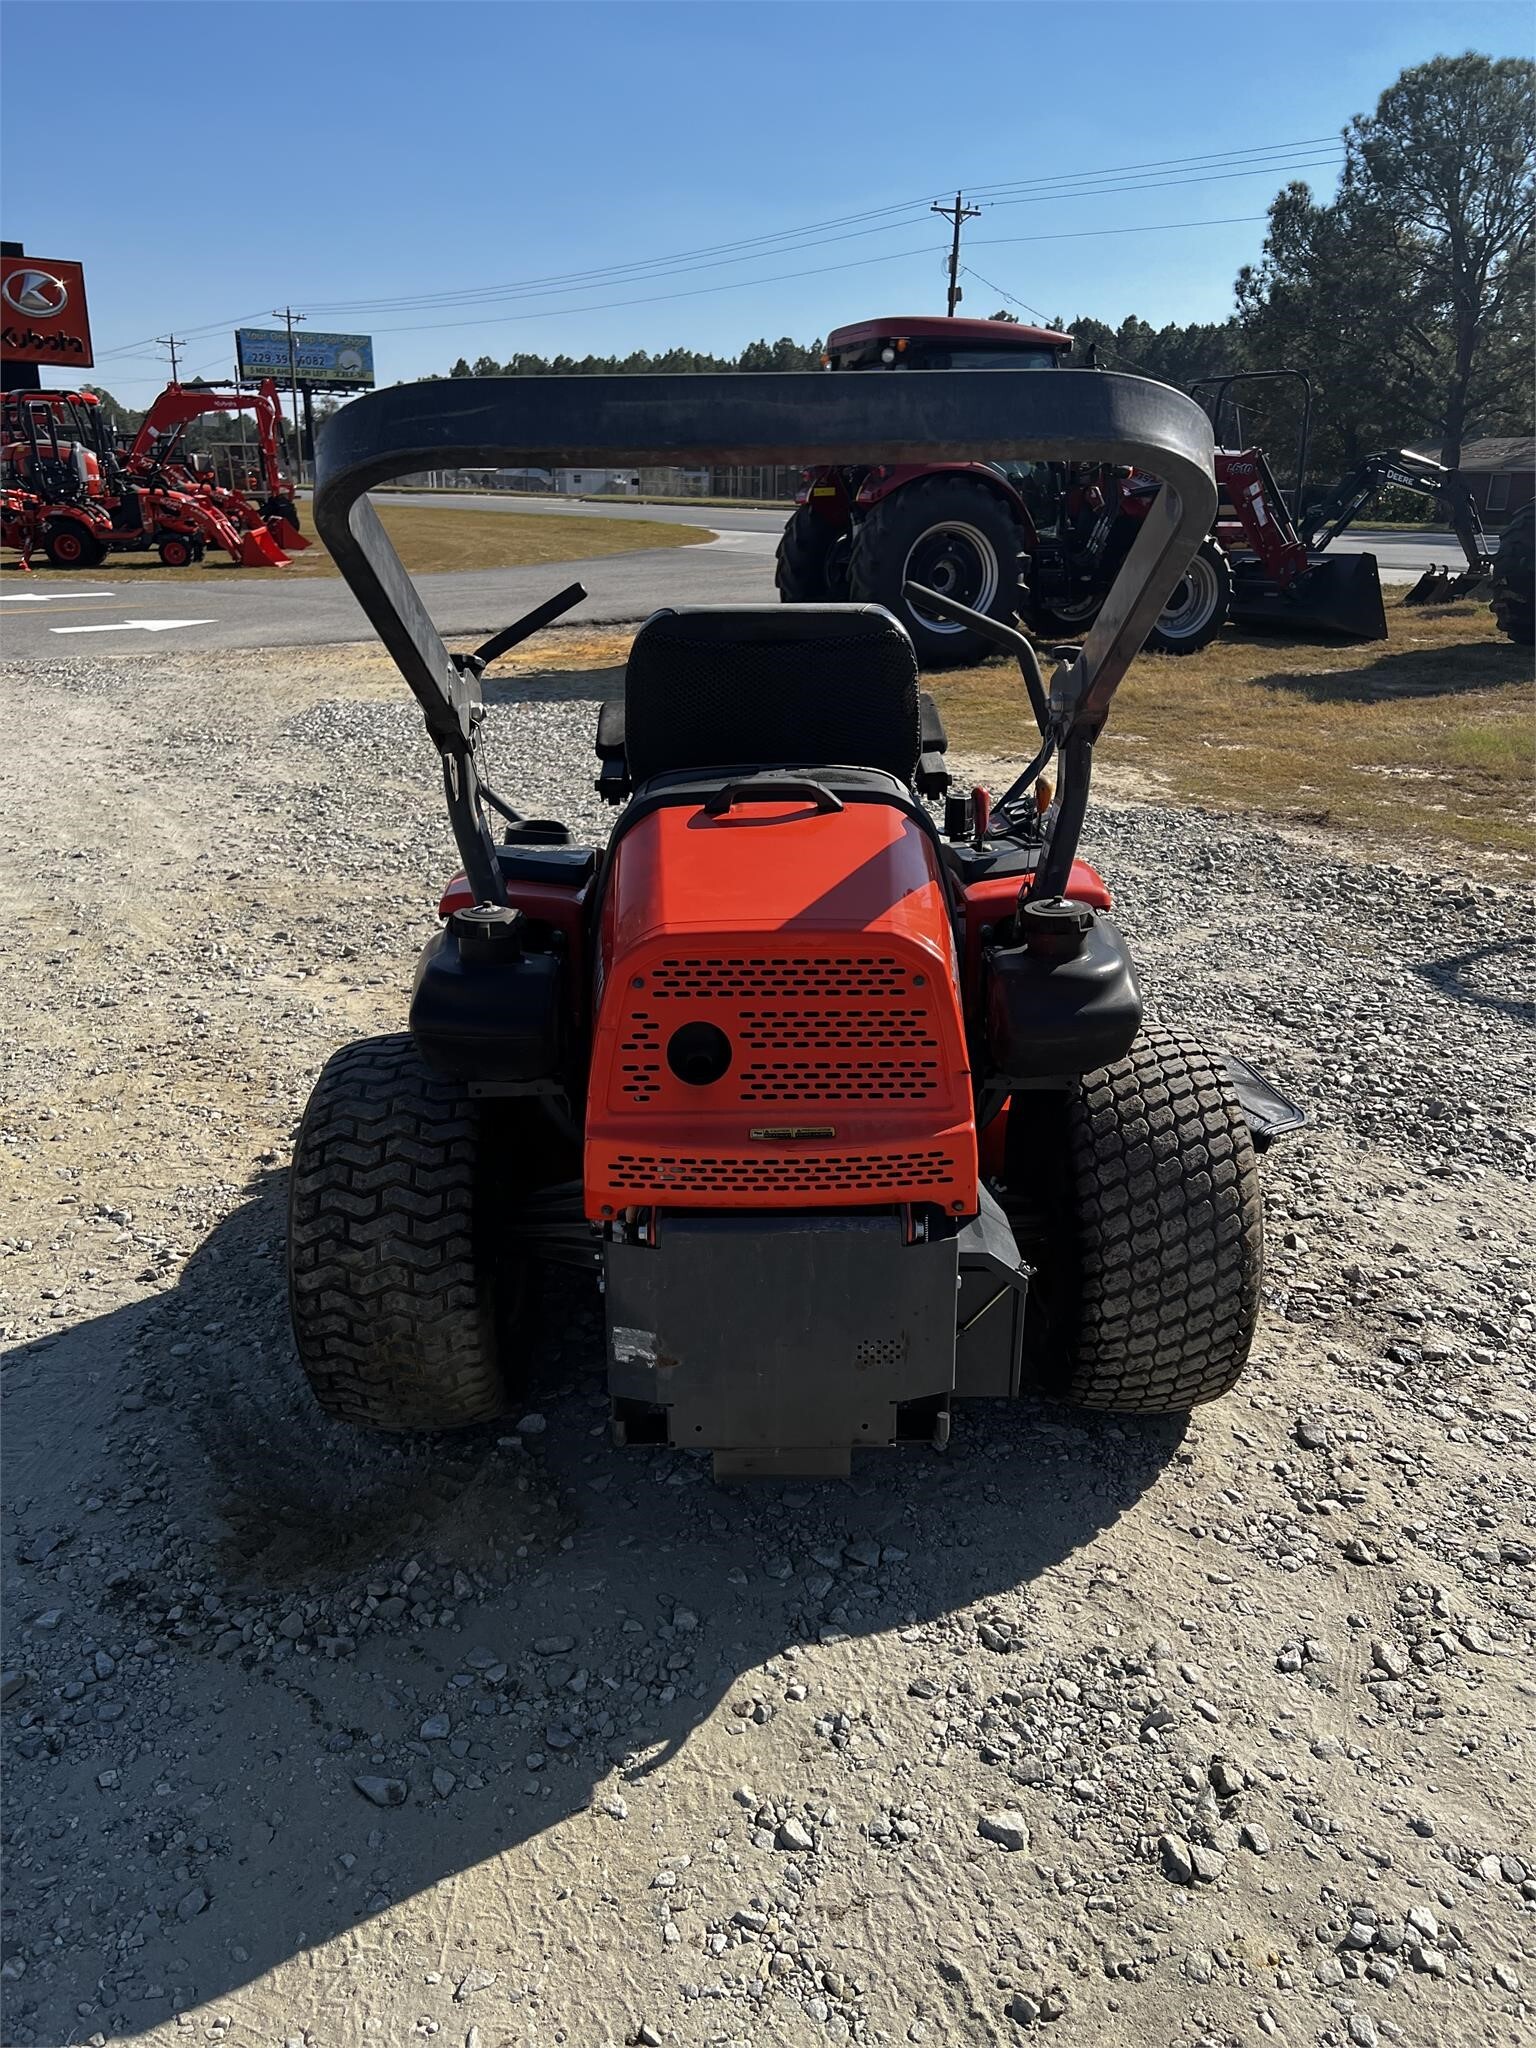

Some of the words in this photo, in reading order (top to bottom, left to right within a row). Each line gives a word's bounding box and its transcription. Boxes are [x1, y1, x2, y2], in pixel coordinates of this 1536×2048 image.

[1, 326, 83, 353] Kubota
[256, 367, 275, 375] MILES
[313, 370, 328, 378] LEFT
[1386, 469, 1415, 486] DEERE
